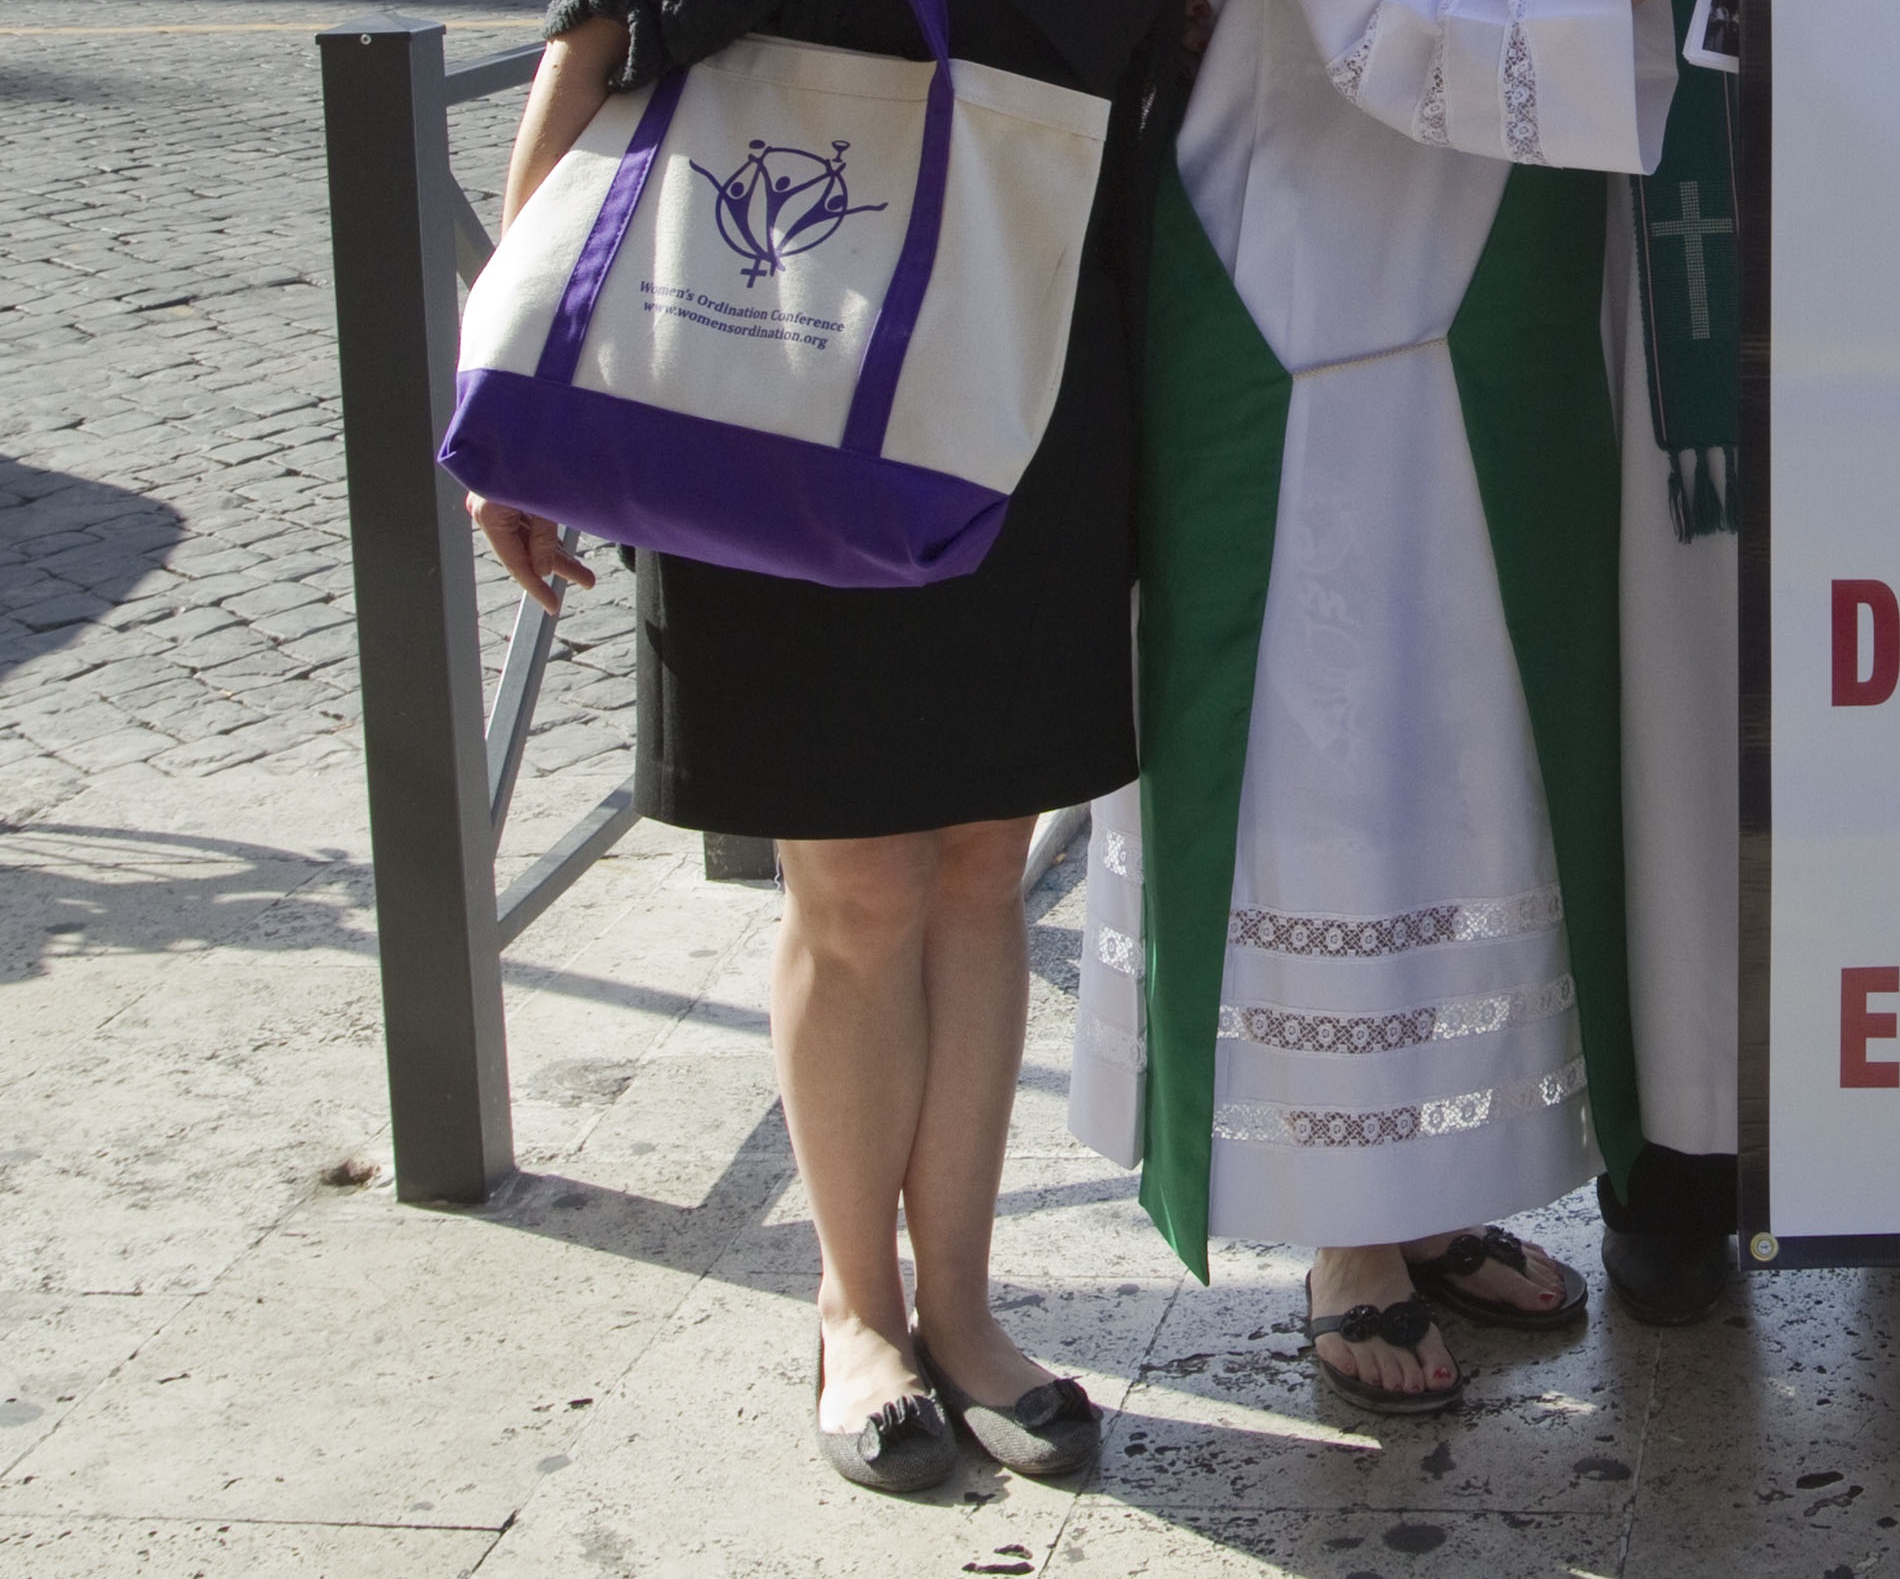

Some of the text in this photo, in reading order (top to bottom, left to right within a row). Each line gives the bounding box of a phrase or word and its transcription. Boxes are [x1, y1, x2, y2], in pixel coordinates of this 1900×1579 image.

[643, 300, 829, 351] www.womensordination.org
[697, 294, 768, 321] Ordination
[770, 309, 845, 333] Conference
